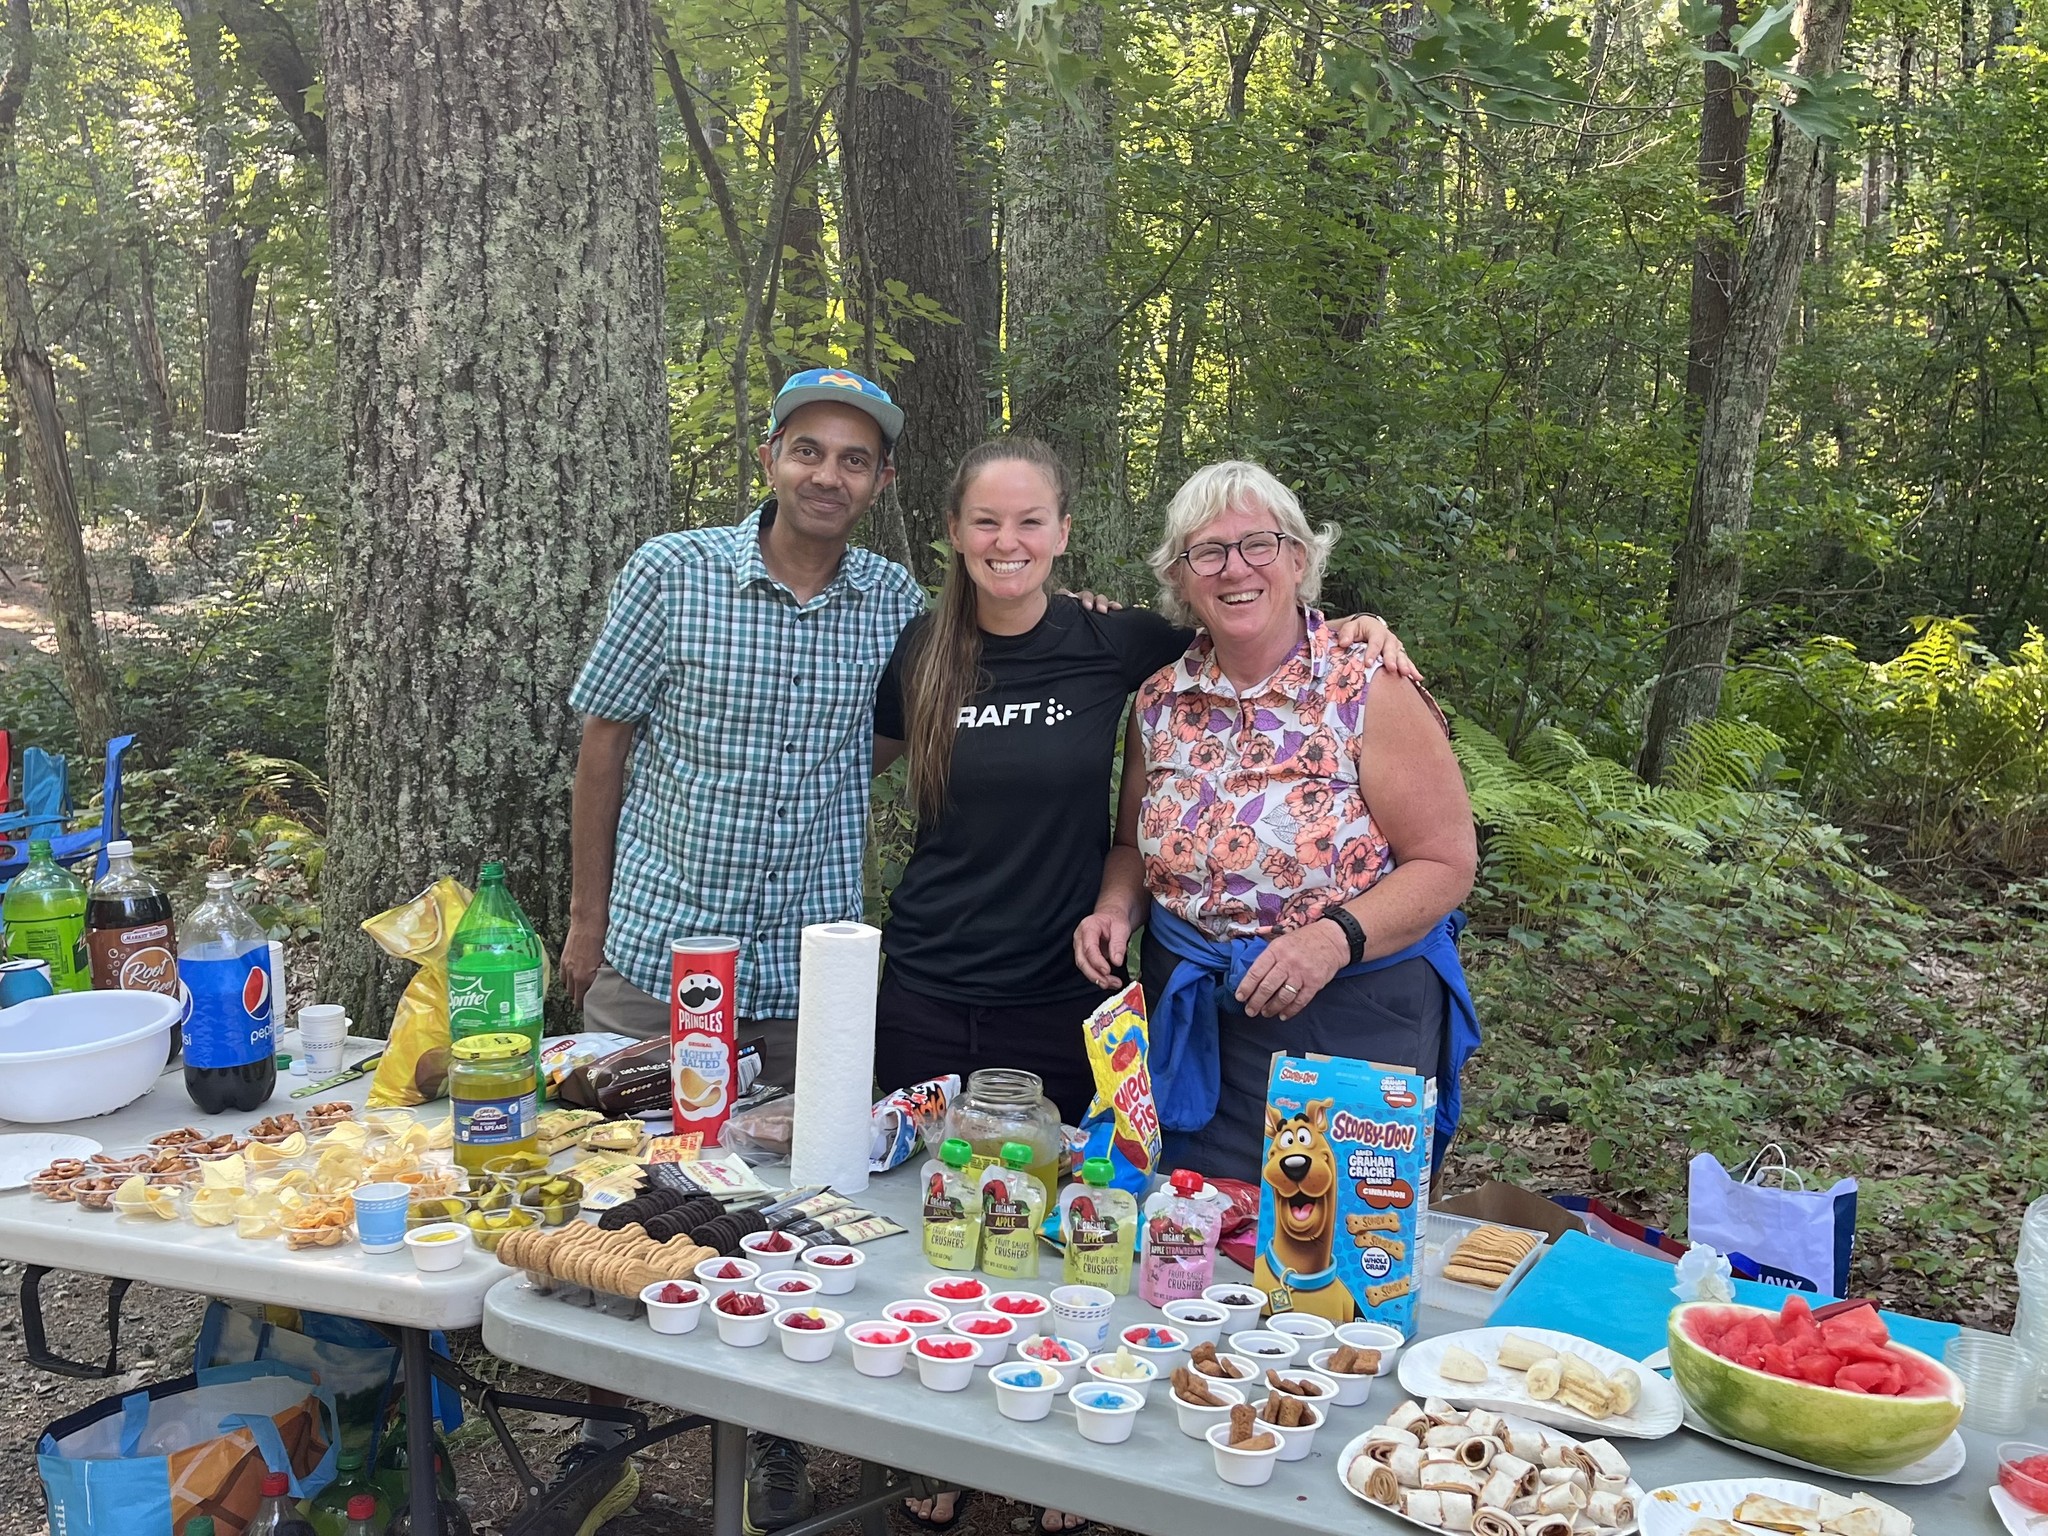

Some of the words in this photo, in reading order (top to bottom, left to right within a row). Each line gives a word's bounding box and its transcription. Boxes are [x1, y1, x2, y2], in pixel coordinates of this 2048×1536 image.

[956, 702, 1041, 728] RAFT
[126, 957, 170, 985] Root
[147, 979, 174, 993] Beer
[449, 991, 485, 1009] Sprite
[678, 1008, 723, 1033] PRINGLES
[250, 1023, 273, 1045] peps
[680, 1049, 723, 1060] LIGHTLY
[681, 1058, 721, 1069] SALTED
[1129, 1102, 1157, 1141] Fis
[1333, 1113, 1415, 1150] SCOOBY-DOO!
[1349, 1155, 1394, 1167] GRAHAM
[1349, 1166, 1395, 1178] CRACKER
[1362, 1188, 1406, 1199] CINNAMON
[995, 1204, 1017, 1214] ORGANIC
[995, 1216, 1016, 1227] APPLE
[948, 1229, 965, 1238] SAUCE
[1083, 1233, 1104, 1243] APPLE
[1162, 1233, 1185, 1242] ORGANIC
[931, 1234, 964, 1248] CRUSHERS
[995, 1238, 1010, 1247] FRUIT
[1012, 1241, 1029, 1249] SAUCE
[994, 1245, 1029, 1259] CRUSHERS
[1151, 1245, 1165, 1254] APPLE
[1083, 1254, 1099, 1264] FRUIT
[1101, 1256, 1119, 1265] SAUCE
[1364, 1257, 1388, 1265] WHOLE
[1083, 1263, 1118, 1275] CRUSHERS
[1168, 1270, 1185, 1279] FRUIT
[1187, 1271, 1205, 1280] SAUCE
[1168, 1278, 1203, 1291] CRUSHERS
[1757, 1273, 1802, 1290] AVY
